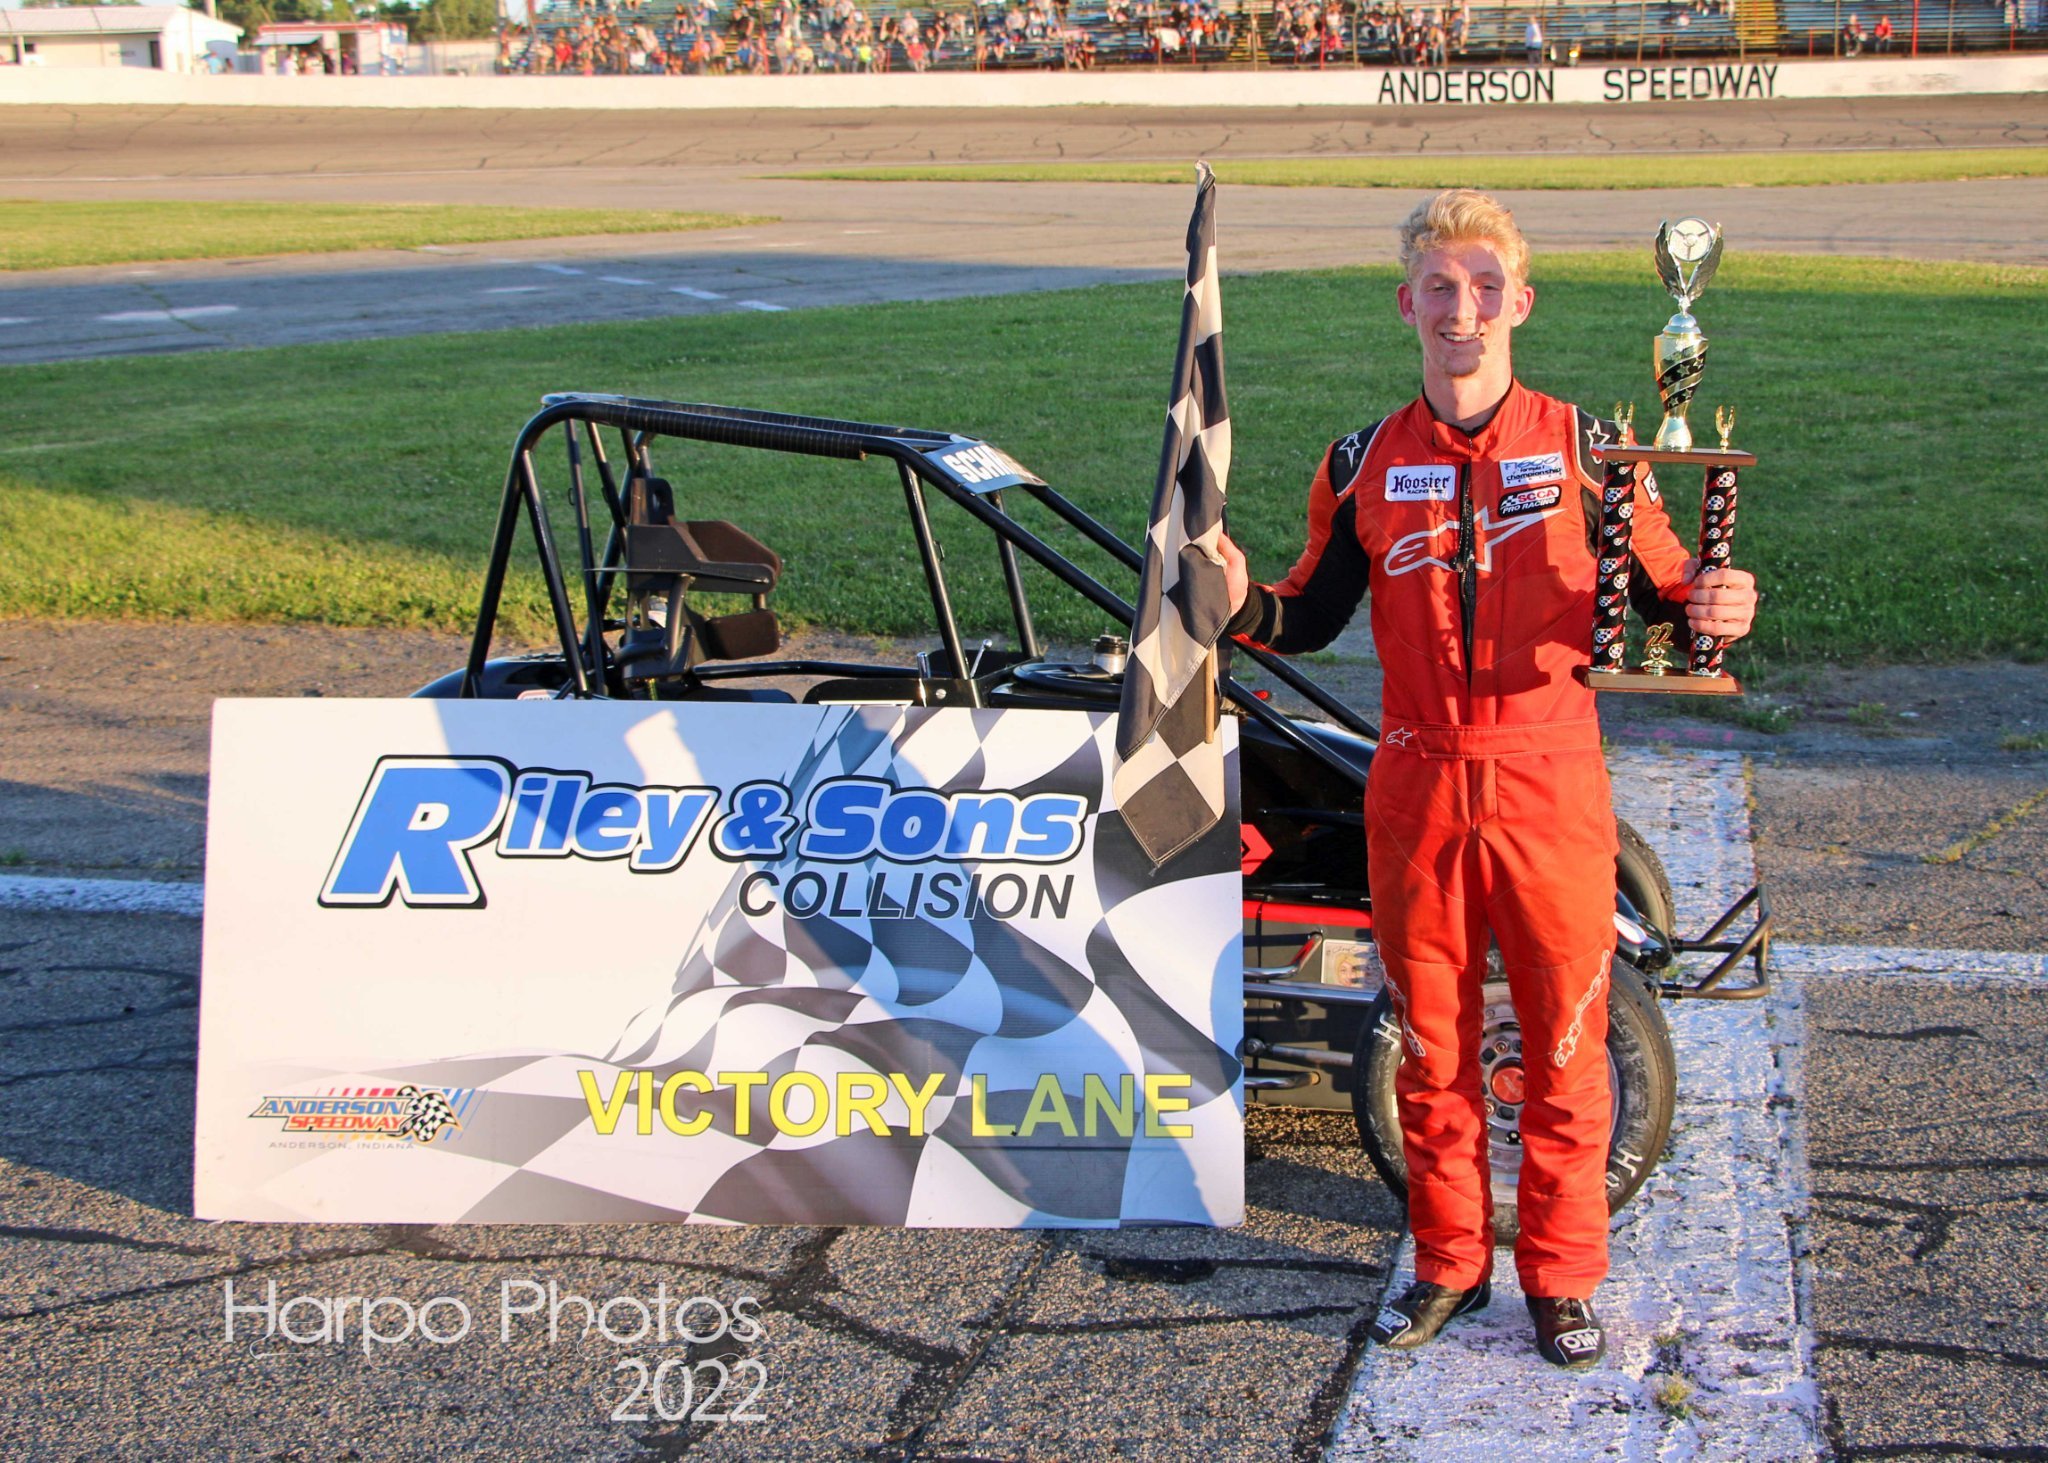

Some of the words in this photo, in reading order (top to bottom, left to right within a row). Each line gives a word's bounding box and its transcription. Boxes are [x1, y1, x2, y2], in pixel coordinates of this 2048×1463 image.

[1378, 70, 1555, 104] ANDERSON
[1603, 64, 1779, 101] SPEEDWAY
[1390, 472, 1451, 493] Hoosier
[1506, 467, 1561, 481] championship
[1517, 489, 1556, 502] SCCA
[1502, 505, 1521, 514] PRO
[1522, 497, 1556, 510] RACING
[318, 755, 719, 909] Riley
[715, 779, 797, 861] &
[798, 775, 1088, 866] Sons
[738, 871, 1076, 921] COLLISION
[261, 1099, 404, 1115] ANDERSON
[577, 1070, 946, 1138] VICTORY
[970, 1073, 1194, 1139] LANE
[288, 1115, 406, 1129] SPEEDWAY
[269, 1141, 352, 1150] ANDERSON,
[357, 1141, 415, 1150] INDIANA
